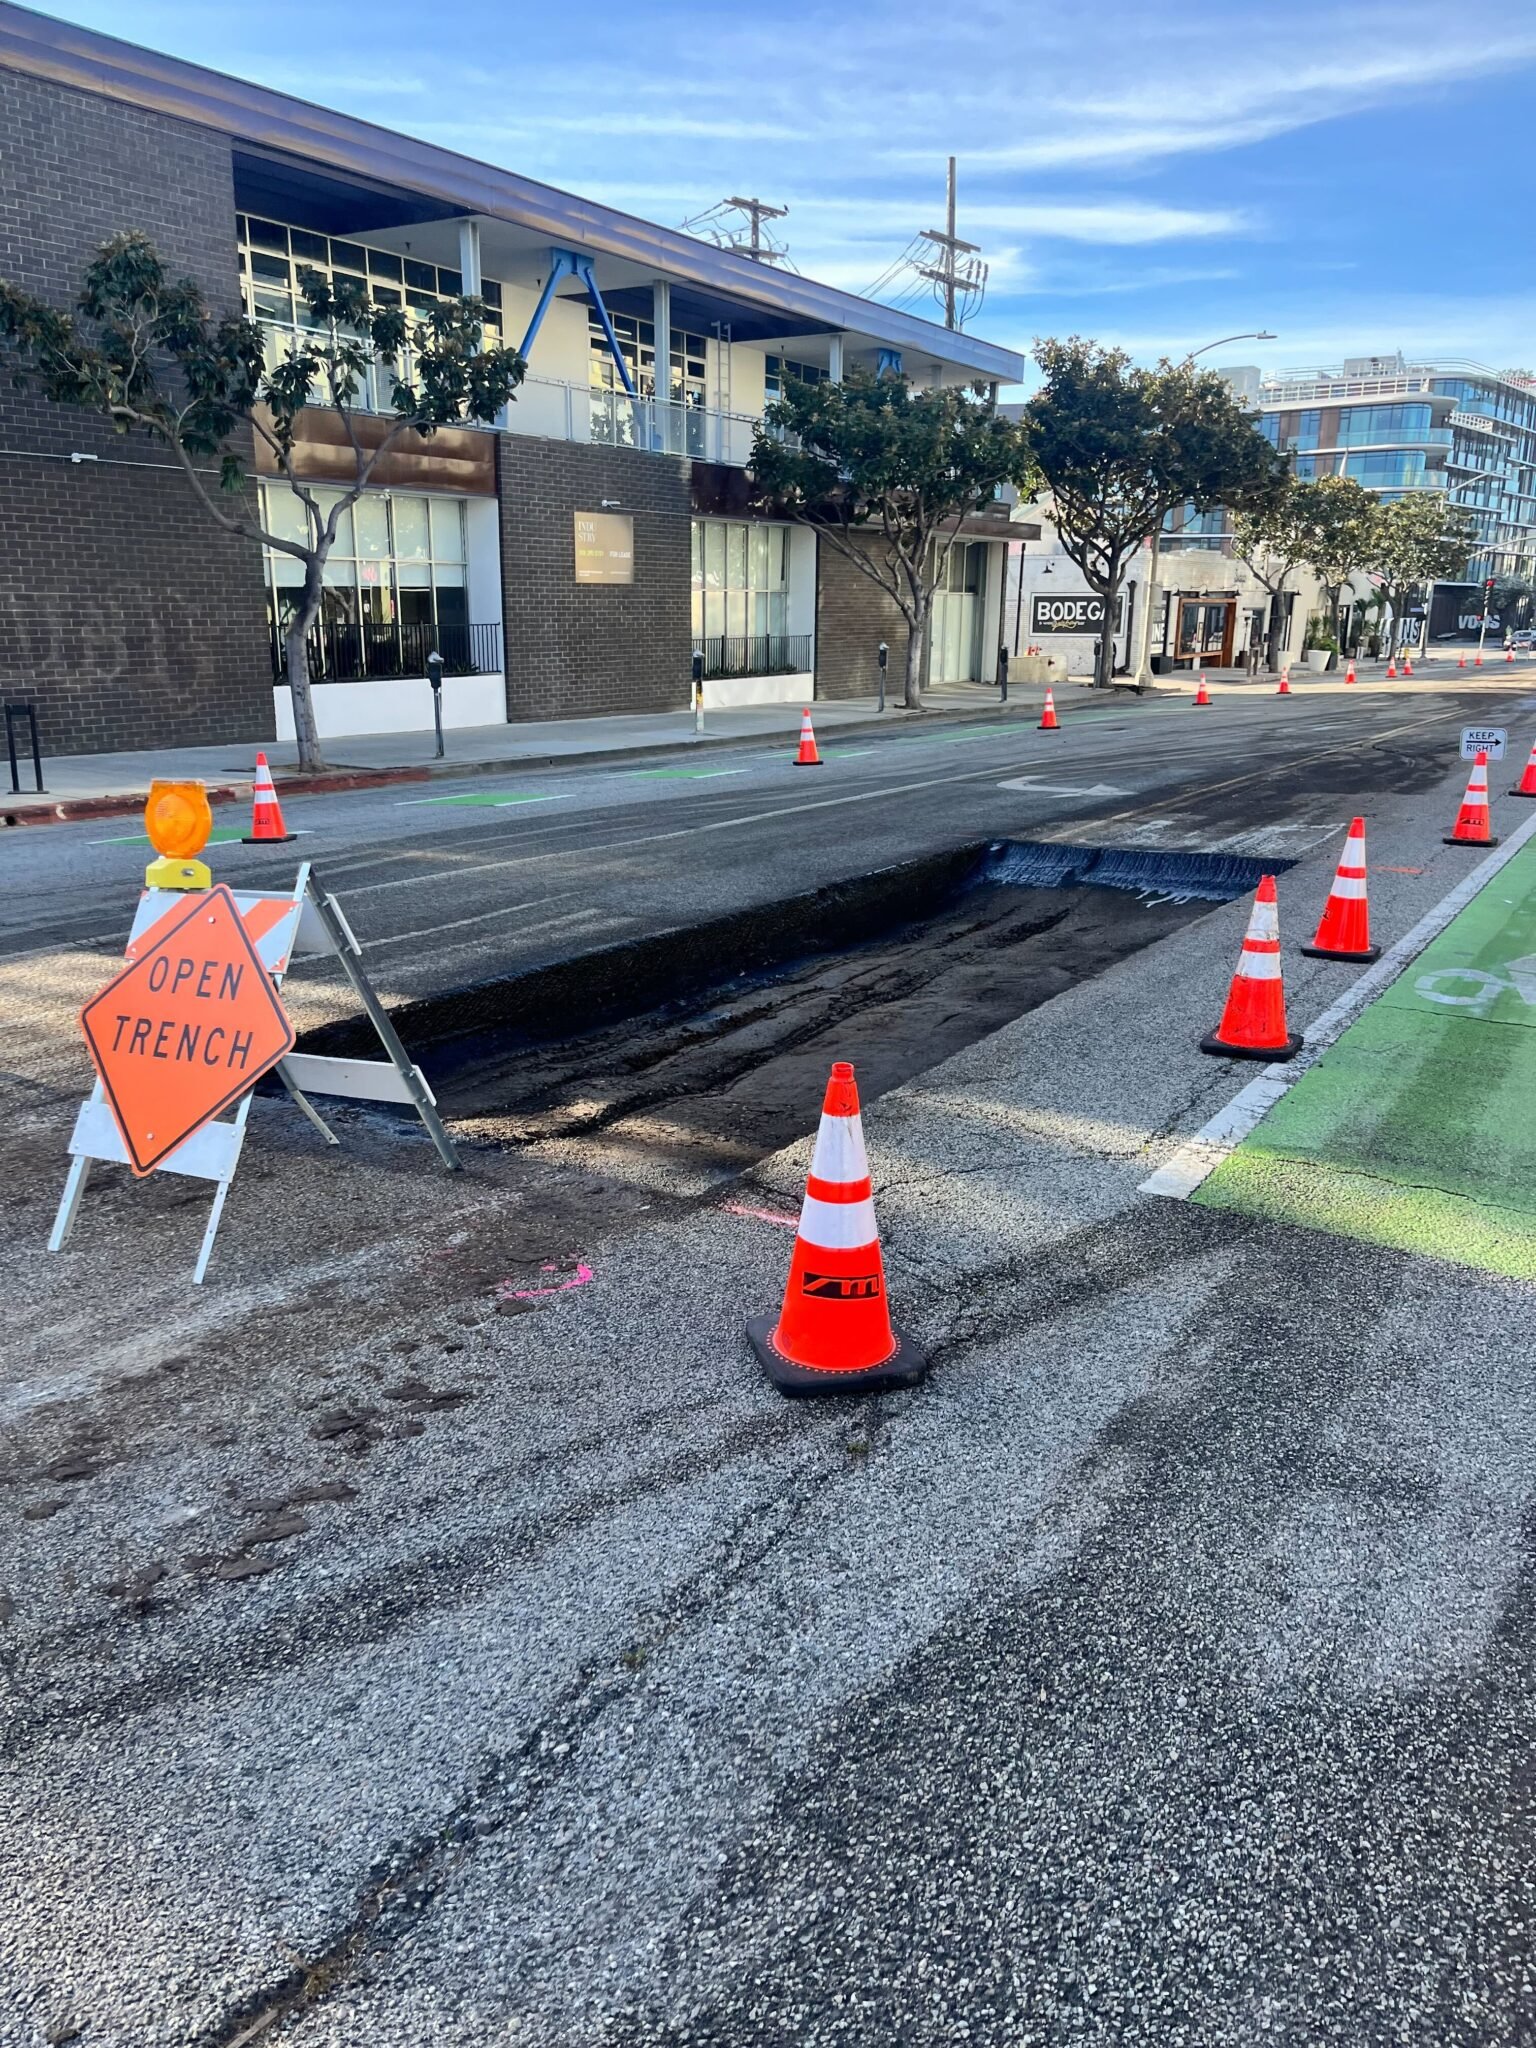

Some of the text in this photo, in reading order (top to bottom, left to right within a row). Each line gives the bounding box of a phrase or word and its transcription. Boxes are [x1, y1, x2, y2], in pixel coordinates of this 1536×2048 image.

[1466, 744, 1494, 753] RIGHT
[1468, 731, 1495, 740] KEEP
[149, 956, 244, 1000] OPEN
[112, 1015, 254, 1069] TRENCH
